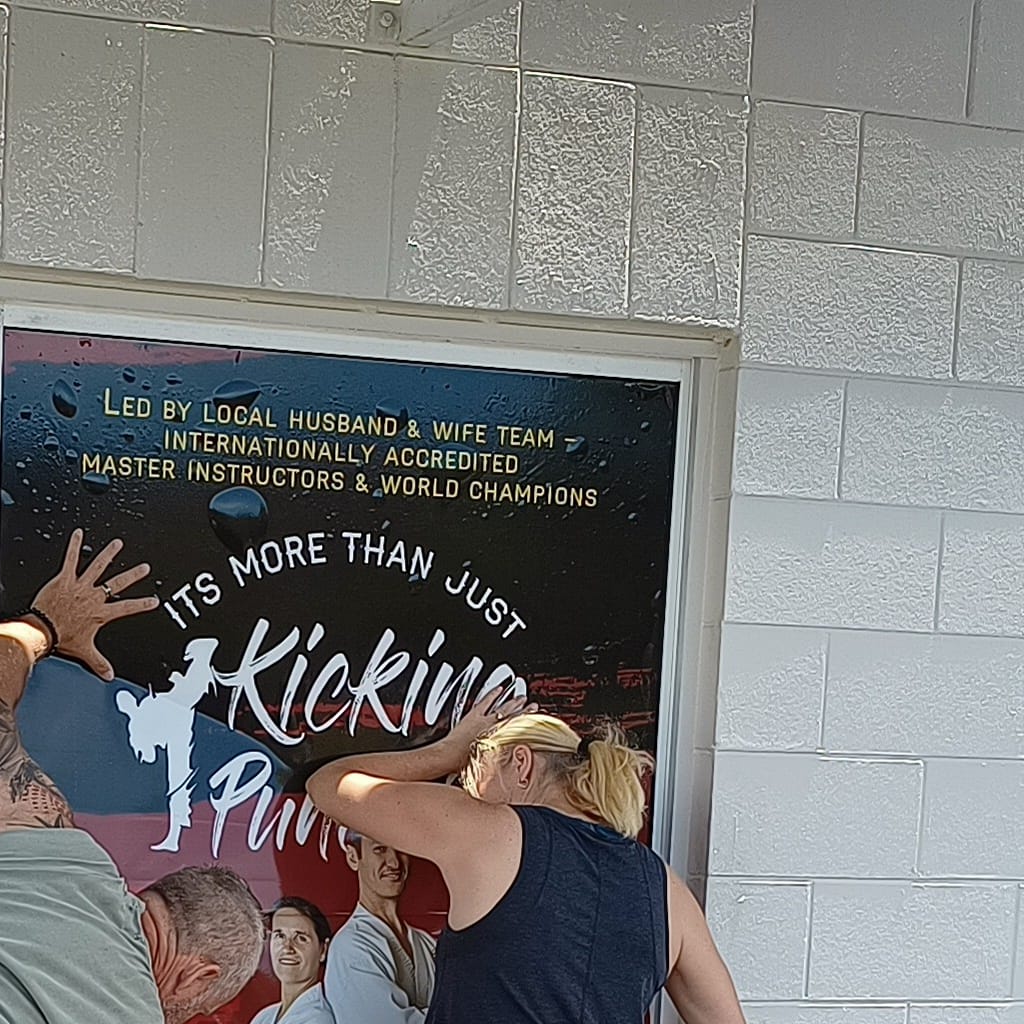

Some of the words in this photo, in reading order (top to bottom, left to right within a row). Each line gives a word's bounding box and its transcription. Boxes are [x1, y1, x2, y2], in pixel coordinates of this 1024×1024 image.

[163, 401, 193, 423] BY
[203, 403, 278, 430] LOCAL
[289, 409, 398, 437] HUSBAND
[407, 420, 421, 439] &
[433, 422, 488, 444] WIFE
[497, 426, 556, 449] TEAM
[164, 430, 376, 465] INTERNATIONALLY
[384, 446, 519, 475] ACCREDITED
[82, 453, 175, 480] MASTER
[187, 459, 344, 491] INSTRUCTORS
[355, 473, 370, 494] &
[381, 474, 459, 500] WORLD
[469, 481, 598, 508] CHAMPIONS
[163, 572, 222, 630] ITS
[229, 532, 328, 588] MORE
[341, 531, 435, 581] THAN
[445, 570, 528, 640] JUST
